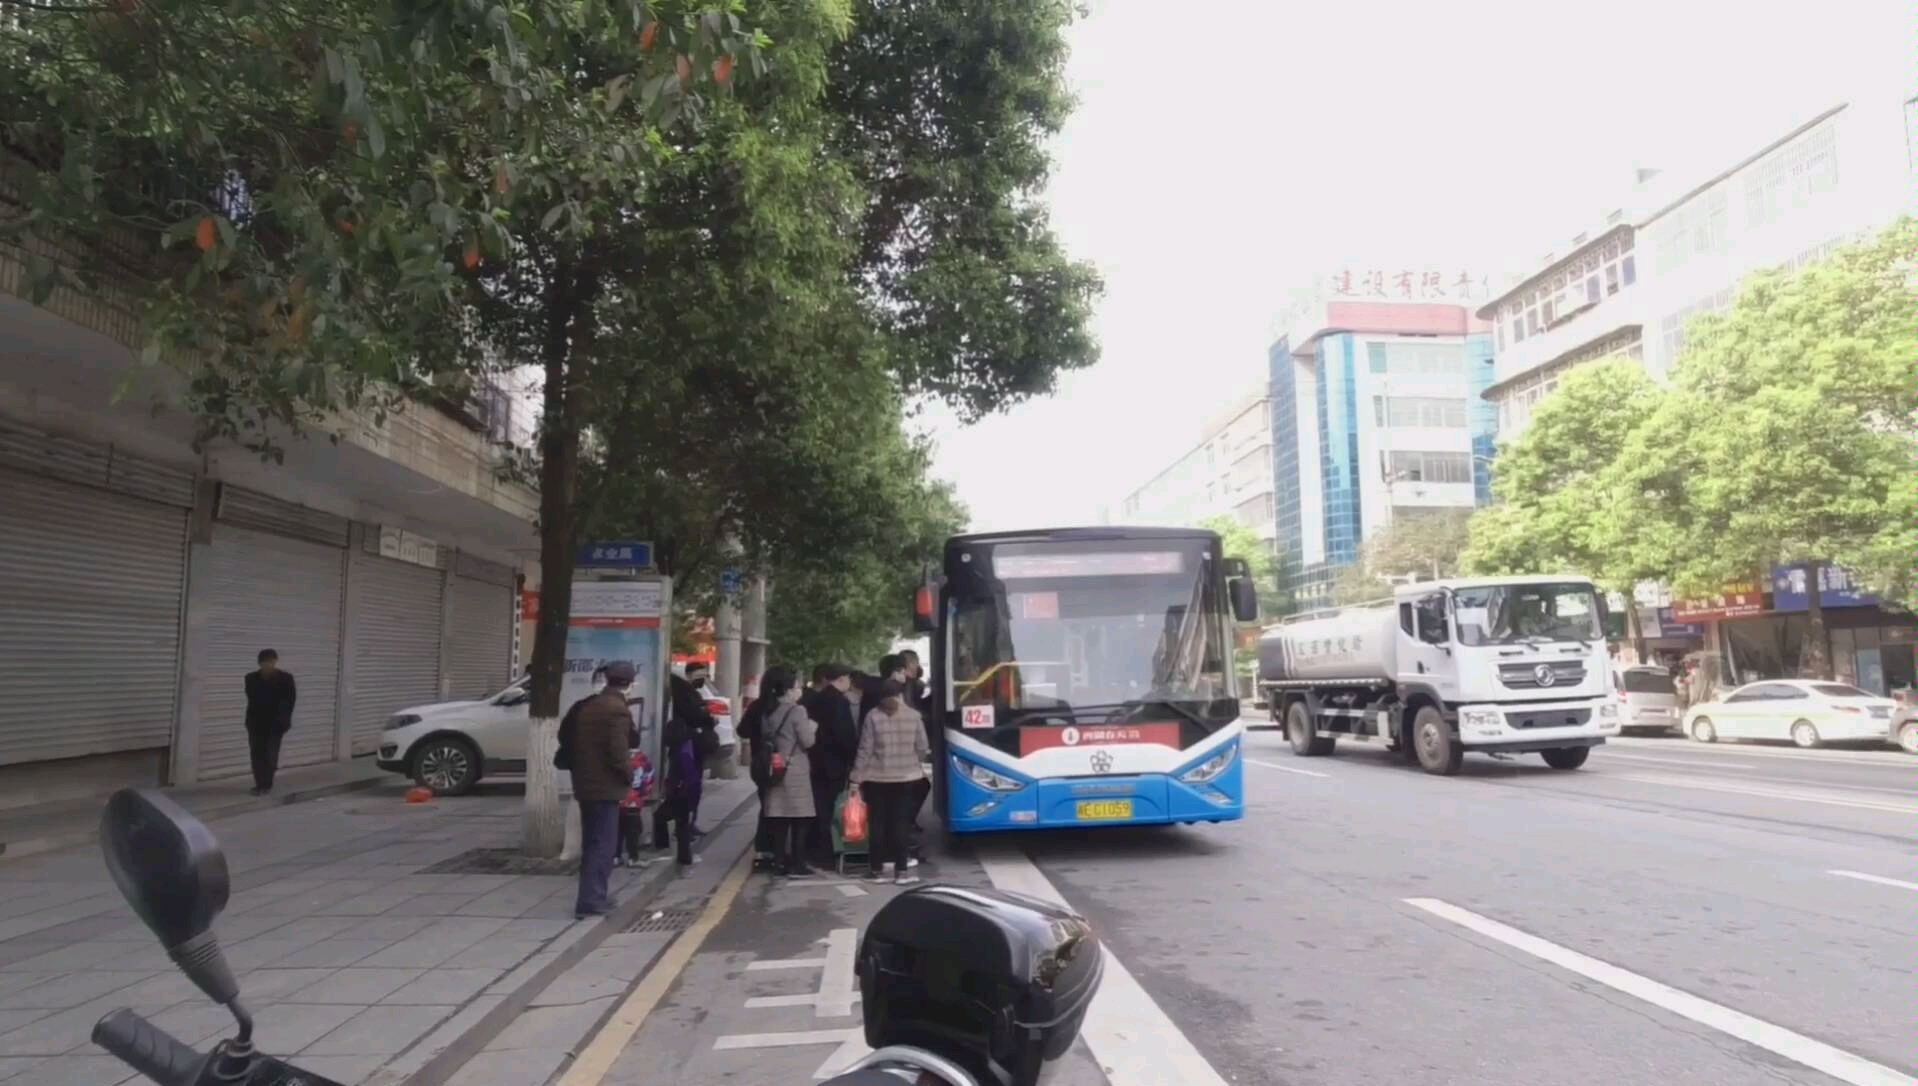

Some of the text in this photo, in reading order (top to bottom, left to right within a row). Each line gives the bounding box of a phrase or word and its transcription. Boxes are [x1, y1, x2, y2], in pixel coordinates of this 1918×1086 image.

[1332, 269, 1489, 301] 建设有限责
